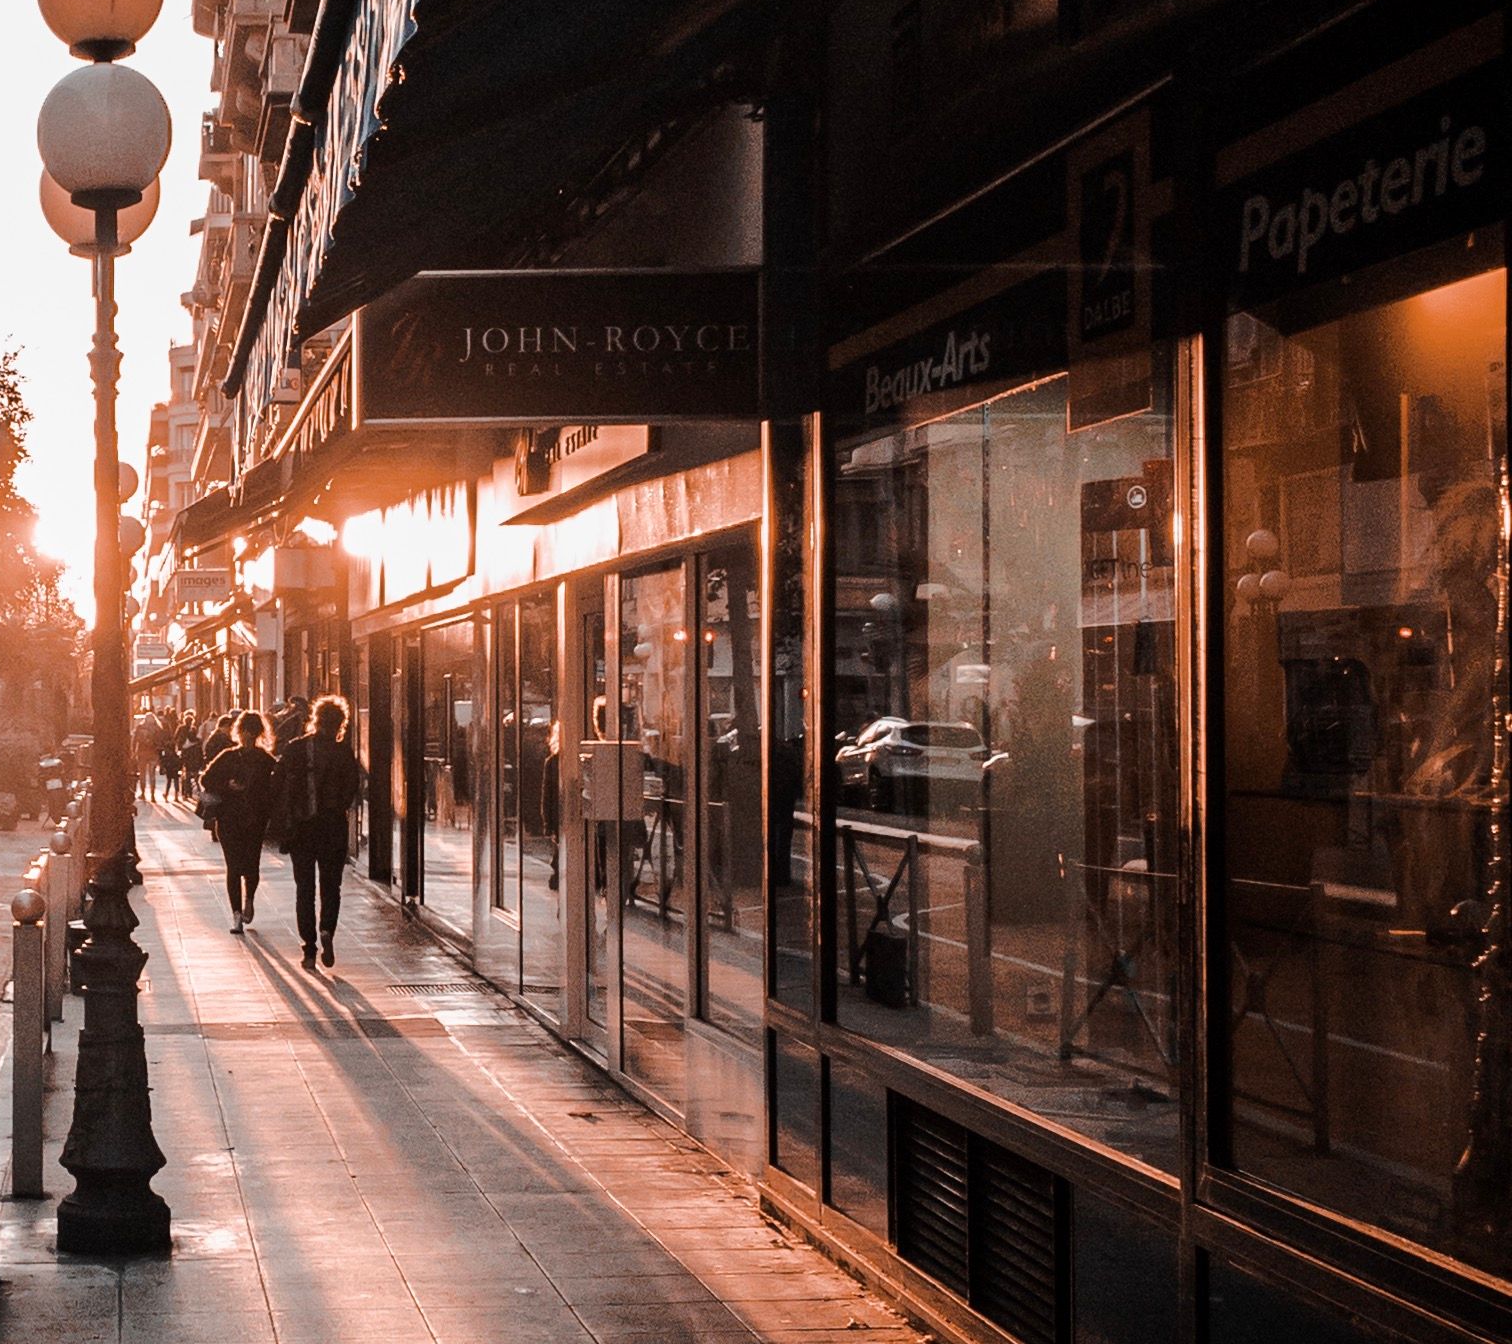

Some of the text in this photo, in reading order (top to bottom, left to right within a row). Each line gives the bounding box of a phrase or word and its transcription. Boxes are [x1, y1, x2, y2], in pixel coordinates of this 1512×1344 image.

[1239, 115, 1486, 273] Papeterie
[459, 325, 751, 363] JOHN-ROYCE
[485, 361, 718, 377] REAL ESTATE
[865, 330, 991, 415] Beaux-Arts
